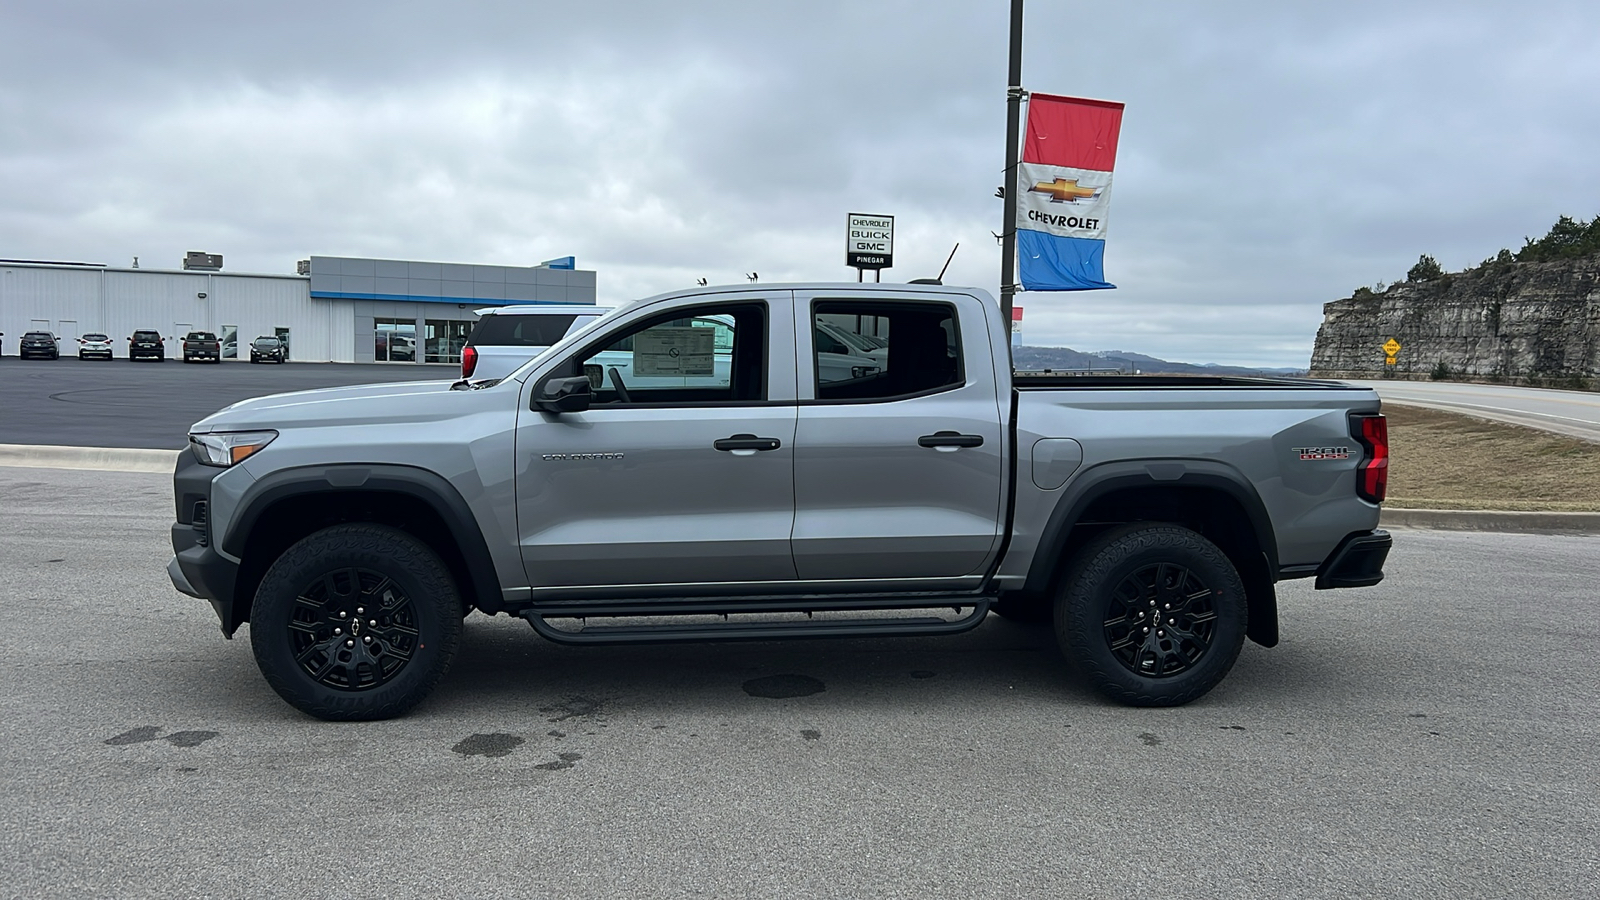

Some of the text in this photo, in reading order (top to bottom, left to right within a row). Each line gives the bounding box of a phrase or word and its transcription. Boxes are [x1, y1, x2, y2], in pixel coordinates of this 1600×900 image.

[852, 219, 890, 228] CHEVROLET
[851, 230, 890, 240] BUICK
[856, 242, 885, 251] GMC
[856, 256, 885, 264] PINEGAR
[1292, 446, 1357, 455] TRAIL
[542, 452, 624, 461] COLORADO
